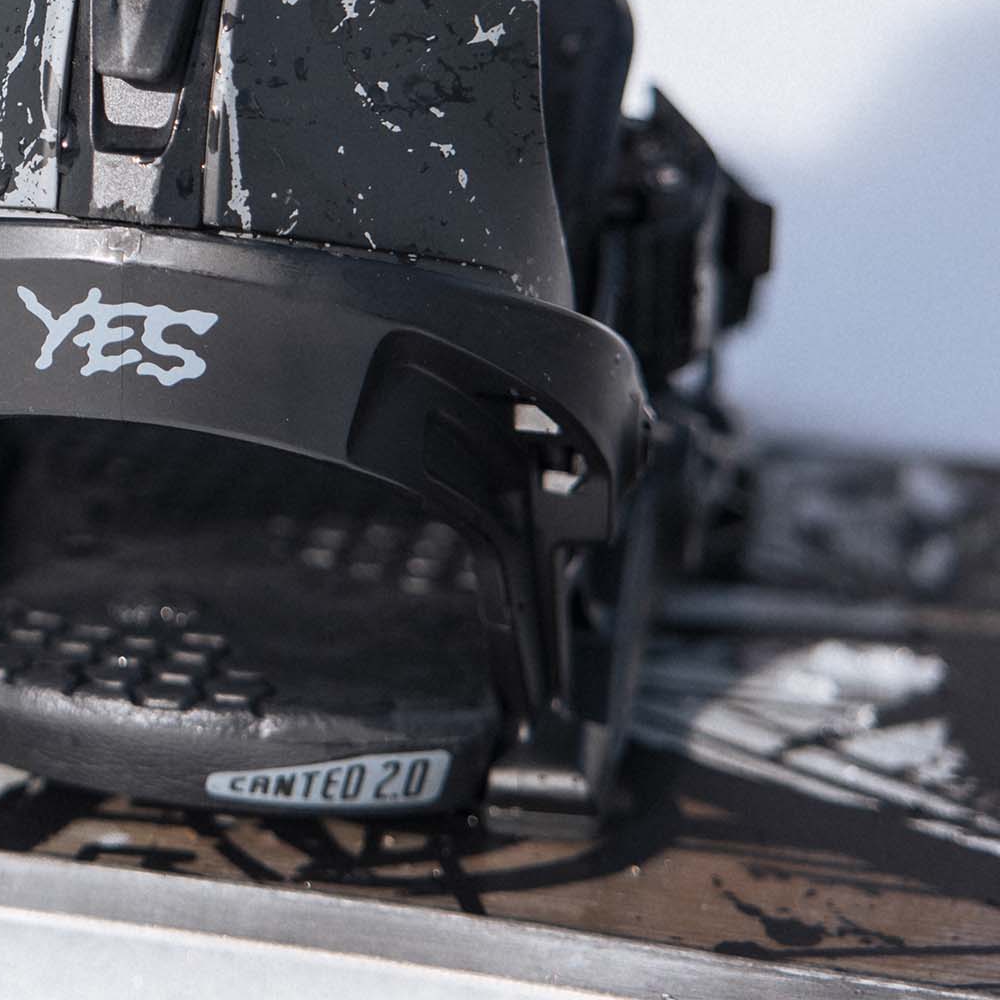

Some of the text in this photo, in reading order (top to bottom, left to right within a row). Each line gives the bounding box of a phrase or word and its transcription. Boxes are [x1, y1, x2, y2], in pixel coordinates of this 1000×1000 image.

[17, 285, 219, 386] YES
[229, 757, 430, 800] CANTED 2.0
